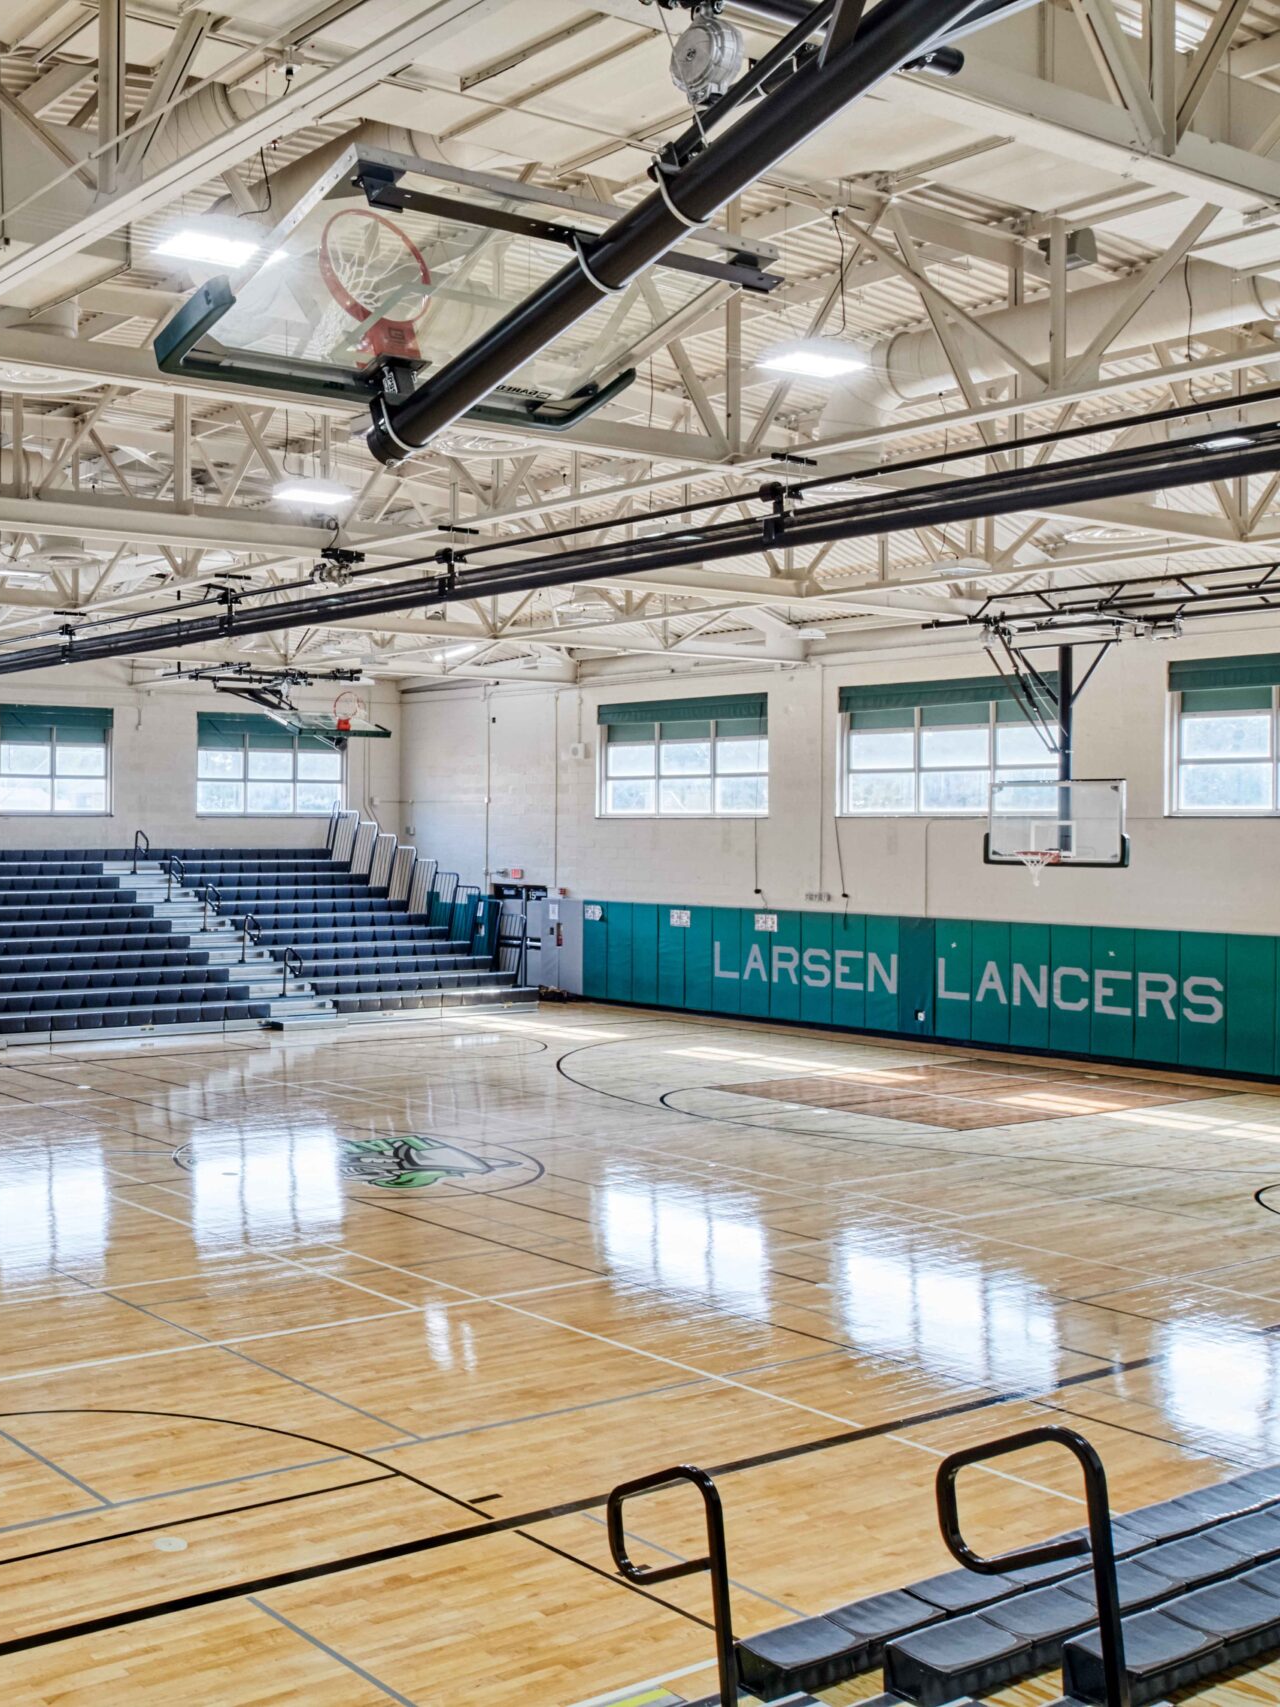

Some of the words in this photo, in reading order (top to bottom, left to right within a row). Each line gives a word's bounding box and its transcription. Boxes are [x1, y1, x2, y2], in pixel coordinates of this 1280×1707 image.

[528, 891, 537, 900] 15
[714, 941, 898, 994] LARSEN
[937, 957, 1224, 1024] LANCERS
